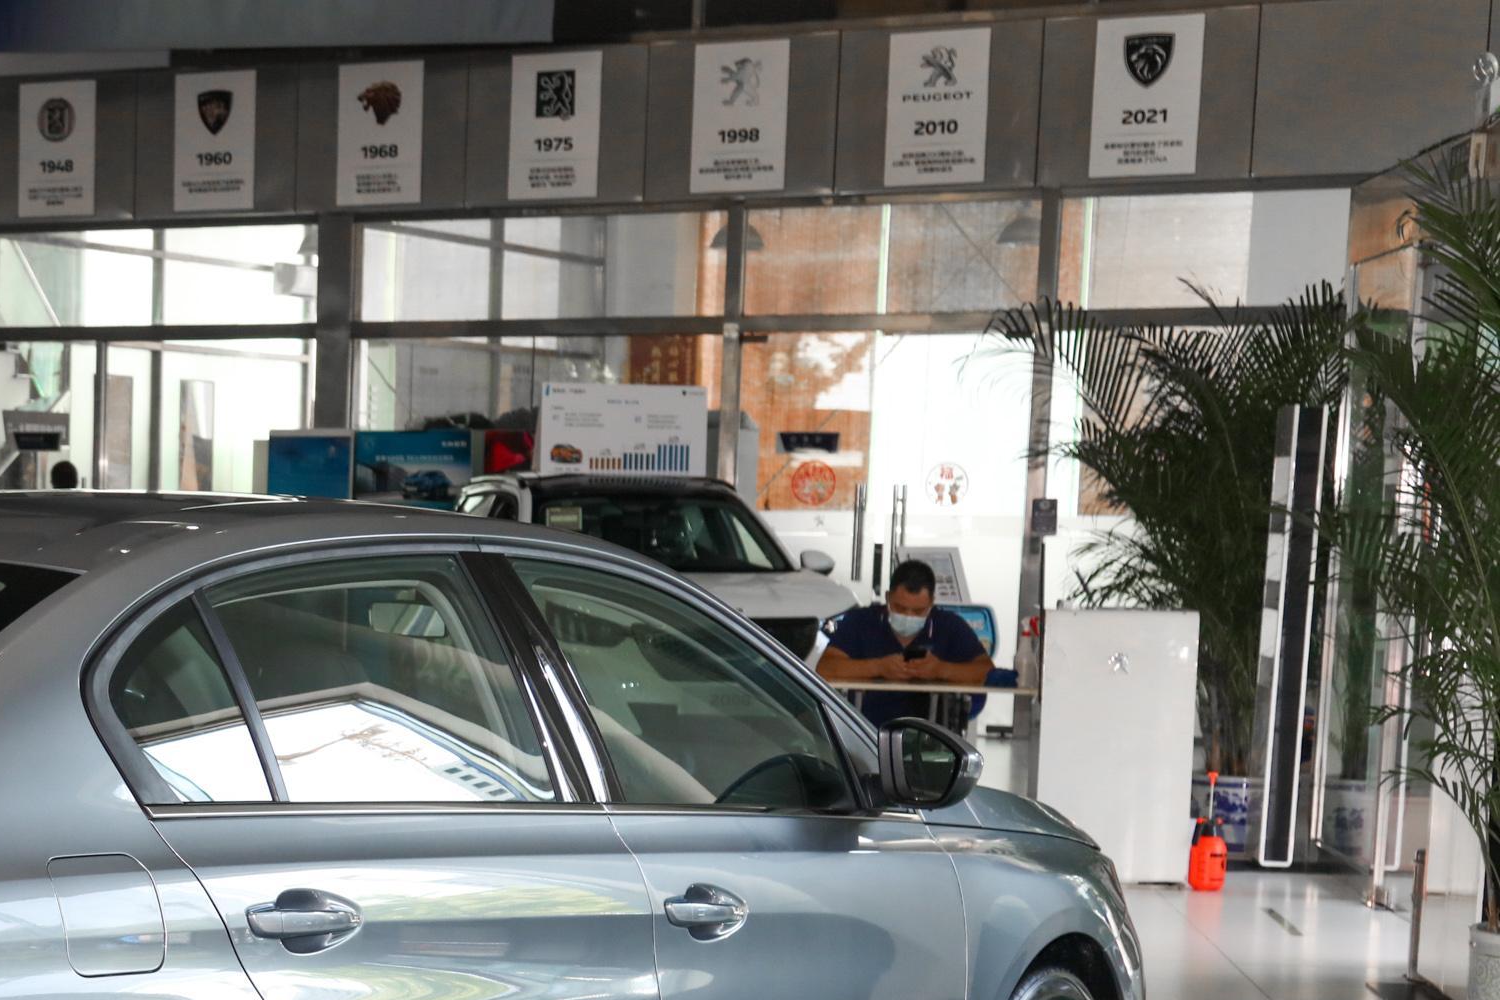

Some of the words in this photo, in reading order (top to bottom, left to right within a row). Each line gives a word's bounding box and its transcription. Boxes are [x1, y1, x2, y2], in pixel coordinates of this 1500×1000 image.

[902, 91, 972, 102] PEUGEOT
[1121, 108, 1169, 125] 2021
[913, 119, 959, 136] 2010
[717, 128, 760, 144] 1998
[360, 144, 399, 159] 1968
[533, 137, 575, 152] 1975
[196, 151, 233, 167] 1960
[40, 160, 75, 174] 1948
